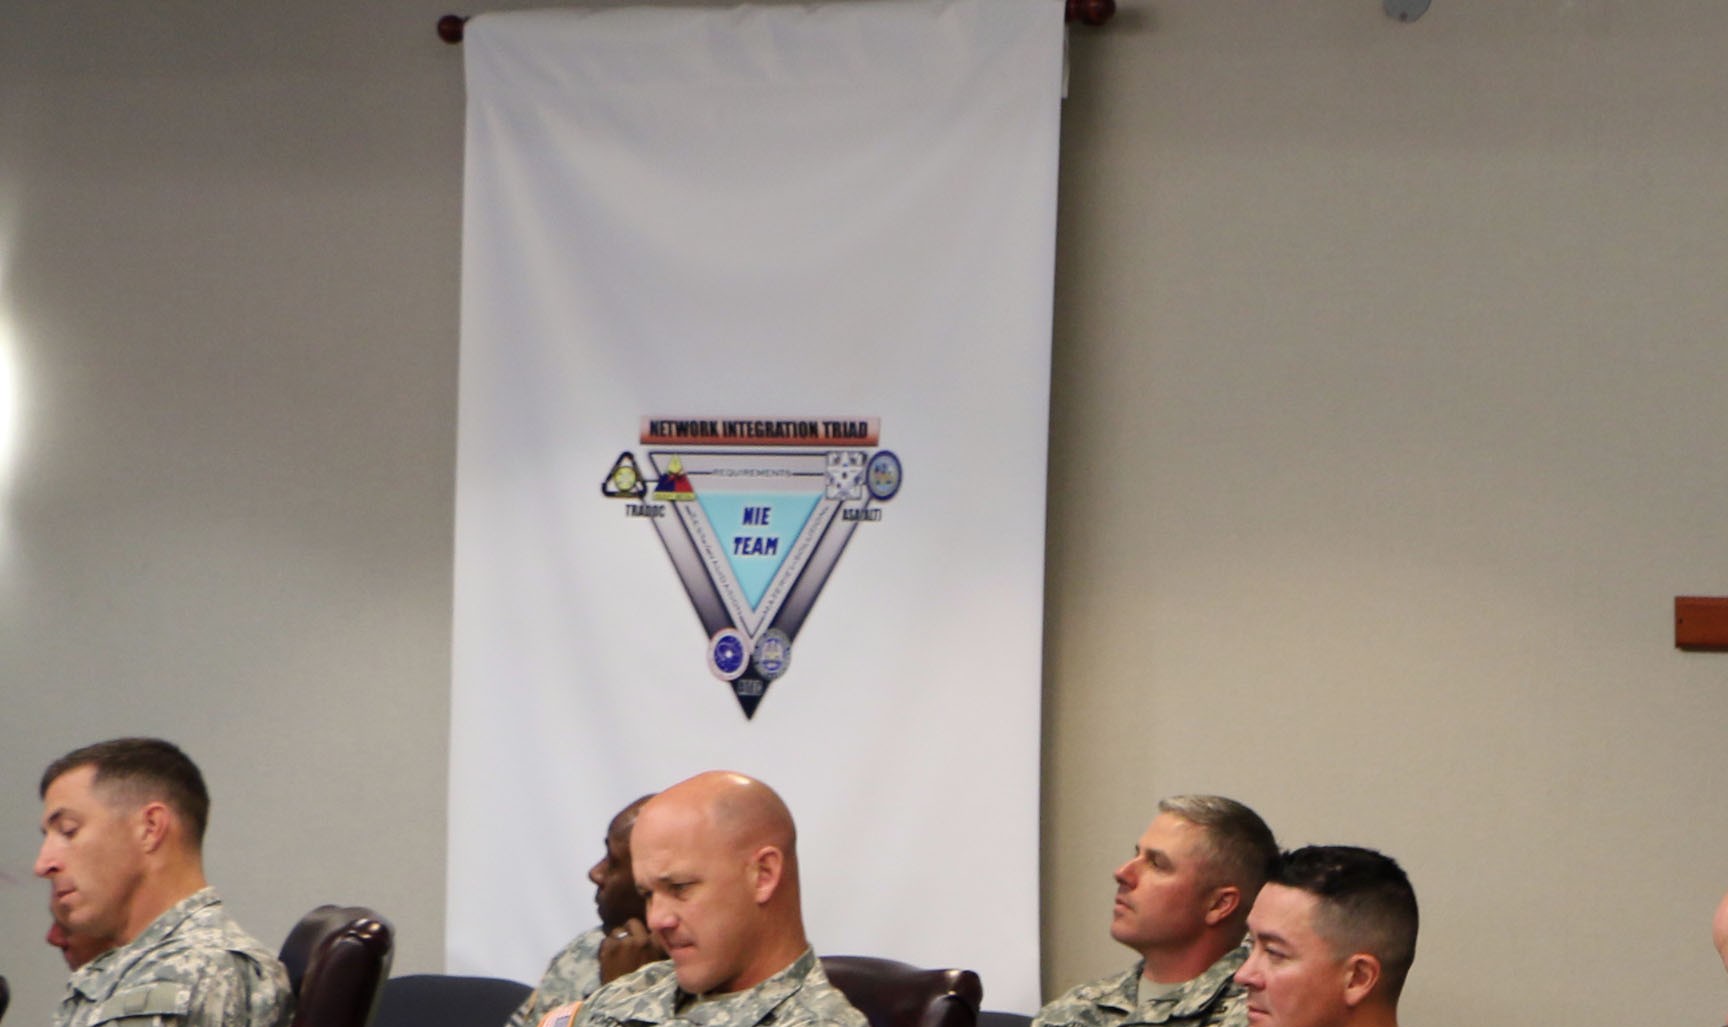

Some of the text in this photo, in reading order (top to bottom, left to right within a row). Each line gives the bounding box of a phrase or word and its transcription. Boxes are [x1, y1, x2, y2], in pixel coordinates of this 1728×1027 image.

[650, 420, 868, 439] NETWORK INTEGRATION TRIAD
[712, 467, 794, 478] REQUIREMENTS
[626, 504, 665, 518] TRADOC
[742, 507, 771, 526] NIE
[733, 537, 779, 556] TEAM
